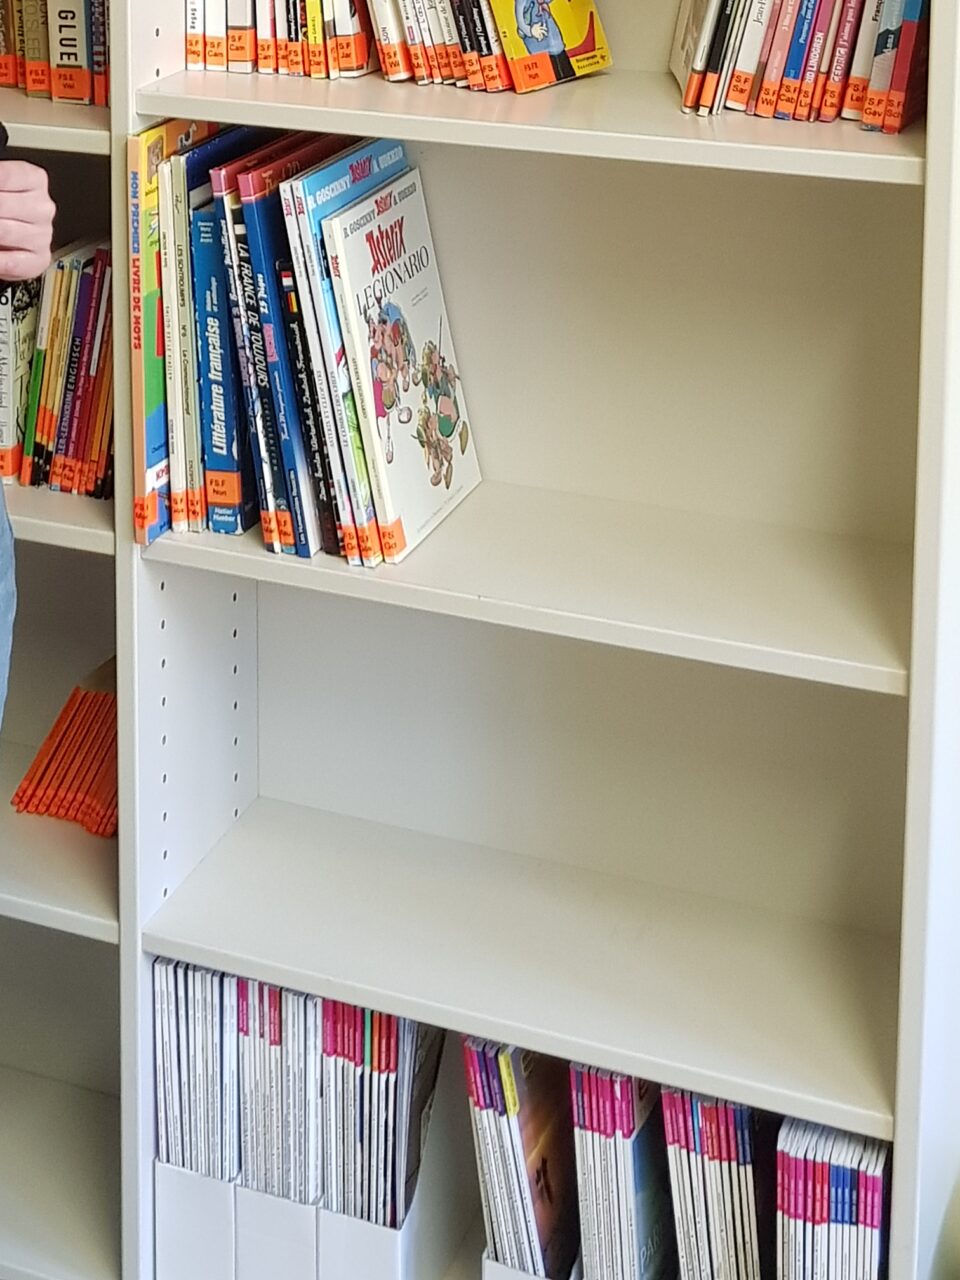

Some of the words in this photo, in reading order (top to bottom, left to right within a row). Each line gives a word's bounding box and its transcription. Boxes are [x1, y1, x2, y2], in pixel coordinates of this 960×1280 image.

[58, 10, 78, 62] GLUE
[839, 22, 850, 45] J'aime
[847, 8, 855, 21] pas
[808, 32, 825, 70] LINDGREN
[131, 171, 139, 199] MON
[131, 203, 140, 254] PREMIER
[365, 215, 407, 278] Asterix
[132, 257, 140, 292] LIVRE
[238, 242, 249, 263] LA
[241, 264, 259, 308] FRANCE
[356, 245, 430, 316] LEGIONARIO
[132, 296, 140, 311] DE
[248, 311, 262, 330] DE
[133, 314, 141, 350] MOTS
[206, 316, 225, 382] française
[68, 337, 82, 389] ENGLISCH
[252, 335, 269, 389] TOUJOURS
[211, 385, 227, 456] Littérature
